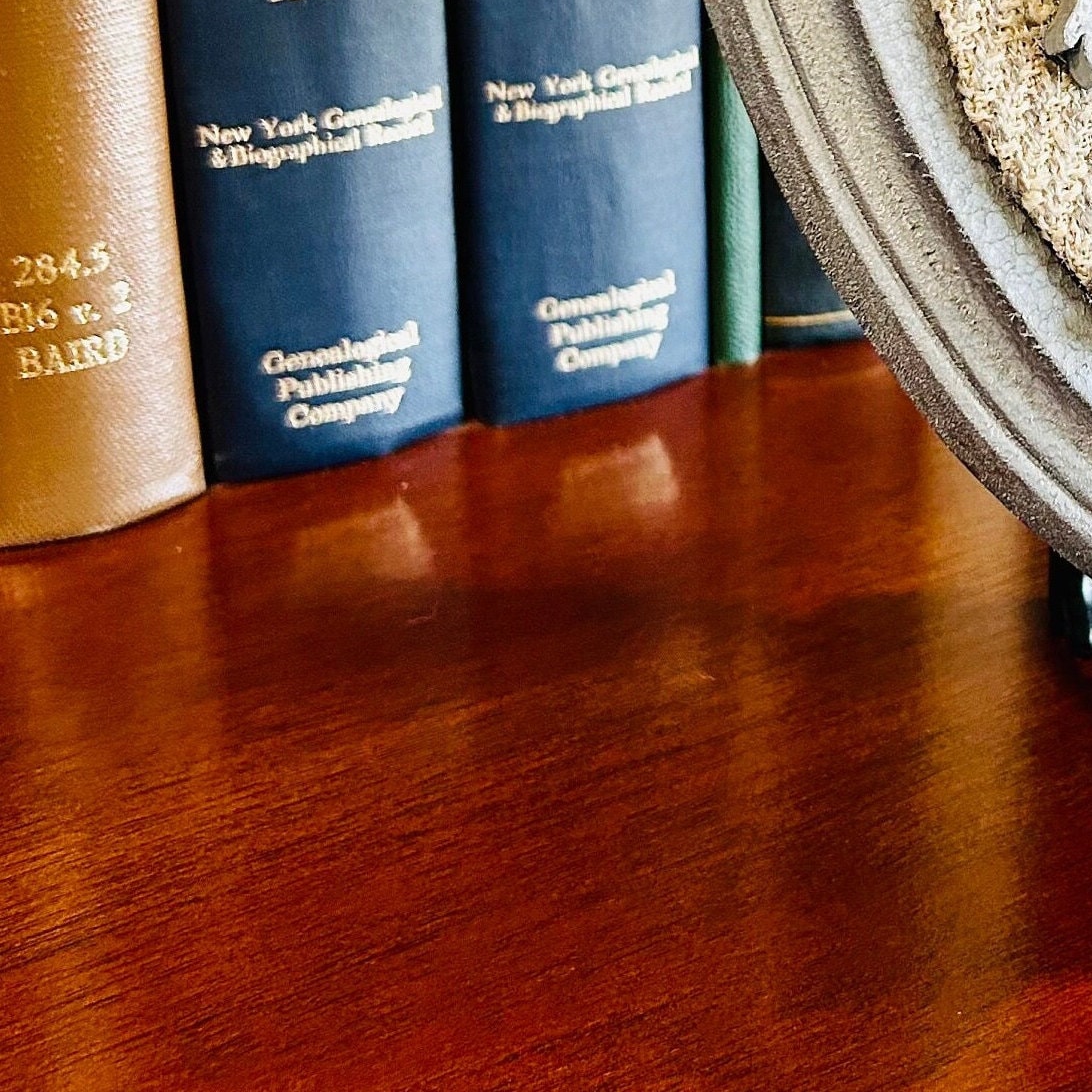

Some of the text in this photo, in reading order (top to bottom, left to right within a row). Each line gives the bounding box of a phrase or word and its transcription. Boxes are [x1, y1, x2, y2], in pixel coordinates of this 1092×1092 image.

[484, 79, 535, 103] New
[543, 69, 593, 95] York
[195, 123, 252, 147] New
[254, 111, 317, 139] York
[227, 128, 362, 169] Biographical
[13, 241, 110, 287] 284.5
[536, 269, 677, 321] Genealogical
[548, 303, 669, 347] Publishing
[16, 328, 130, 379] BAIRD
[261, 320, 420, 375] Genealogical
[555, 332, 663, 373] Company
[276, 357, 411, 402] Publishing
[286, 386, 406, 429] Company
